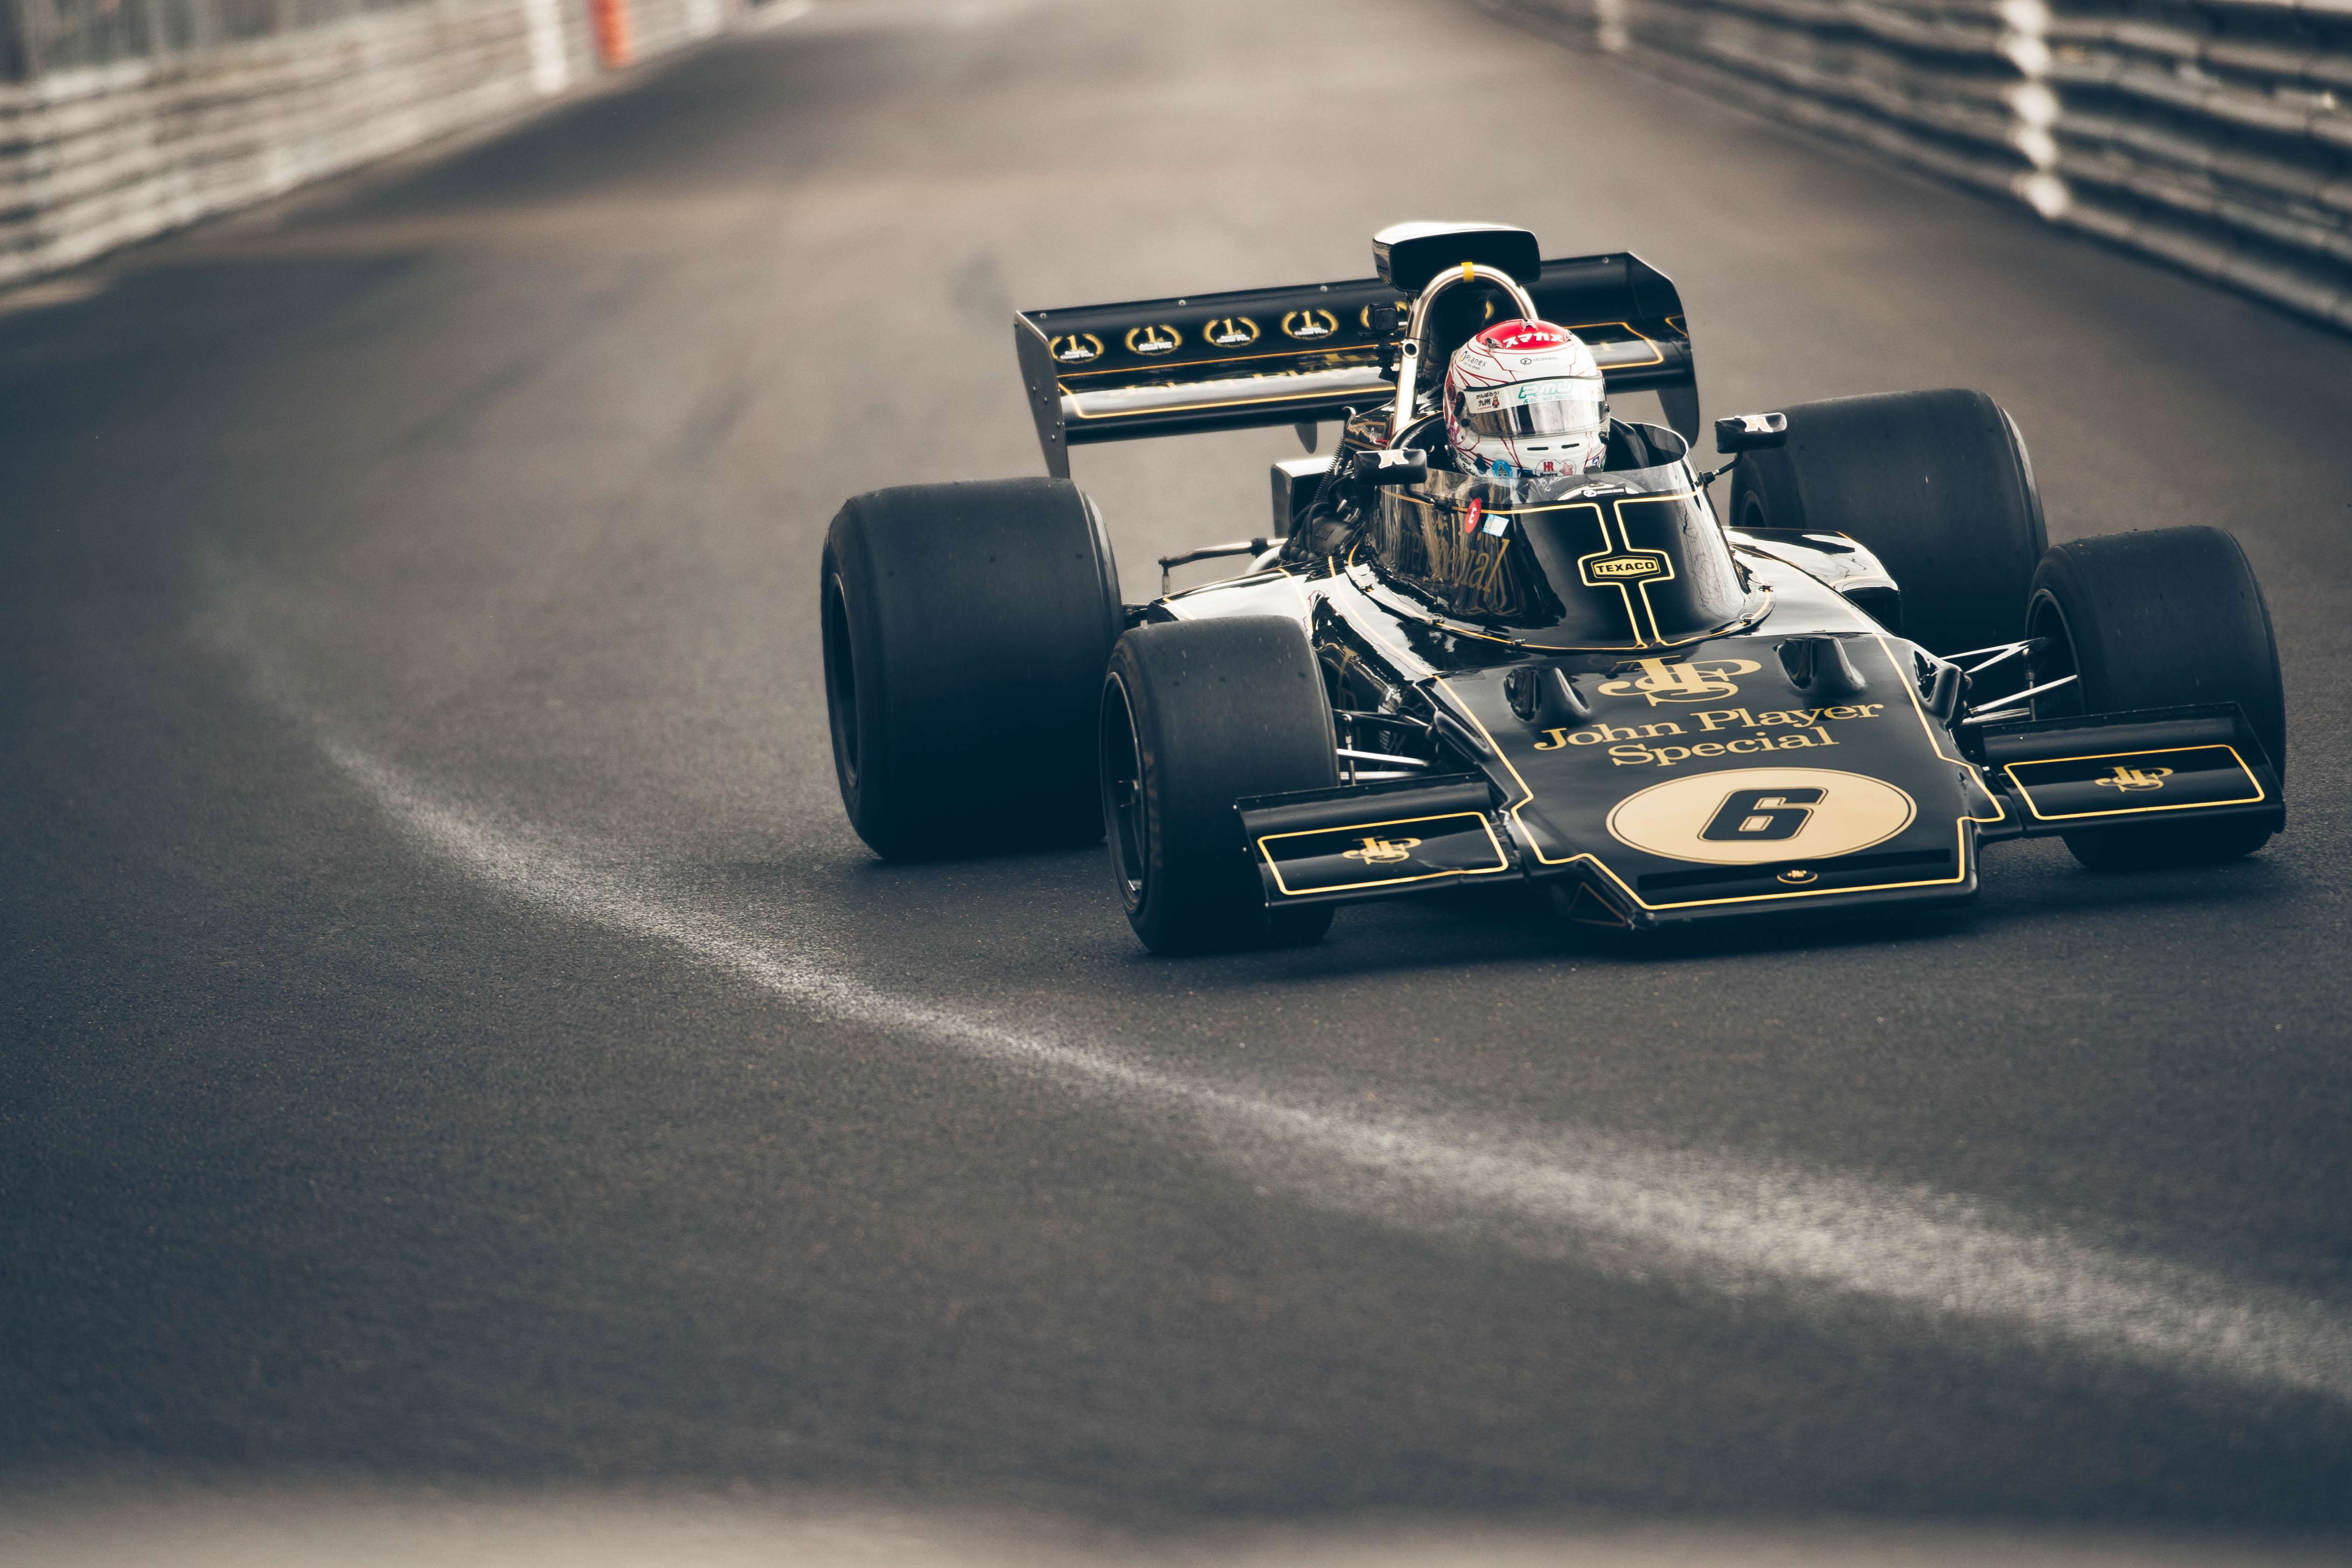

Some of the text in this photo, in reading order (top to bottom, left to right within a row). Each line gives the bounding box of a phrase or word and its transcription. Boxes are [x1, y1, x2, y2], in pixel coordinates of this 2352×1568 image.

[1502, 332, 1563, 349] スマカメ
[1478, 398, 1490, 407] 九州
[1543, 461, 1554, 472] HR
[1468, 507, 1477, 524] E
[1596, 561, 1655, 573] TEXACO
[1533, 704, 1884, 751] John Player
[1608, 726, 1840, 767] Special
[1697, 787, 1829, 842] 6
